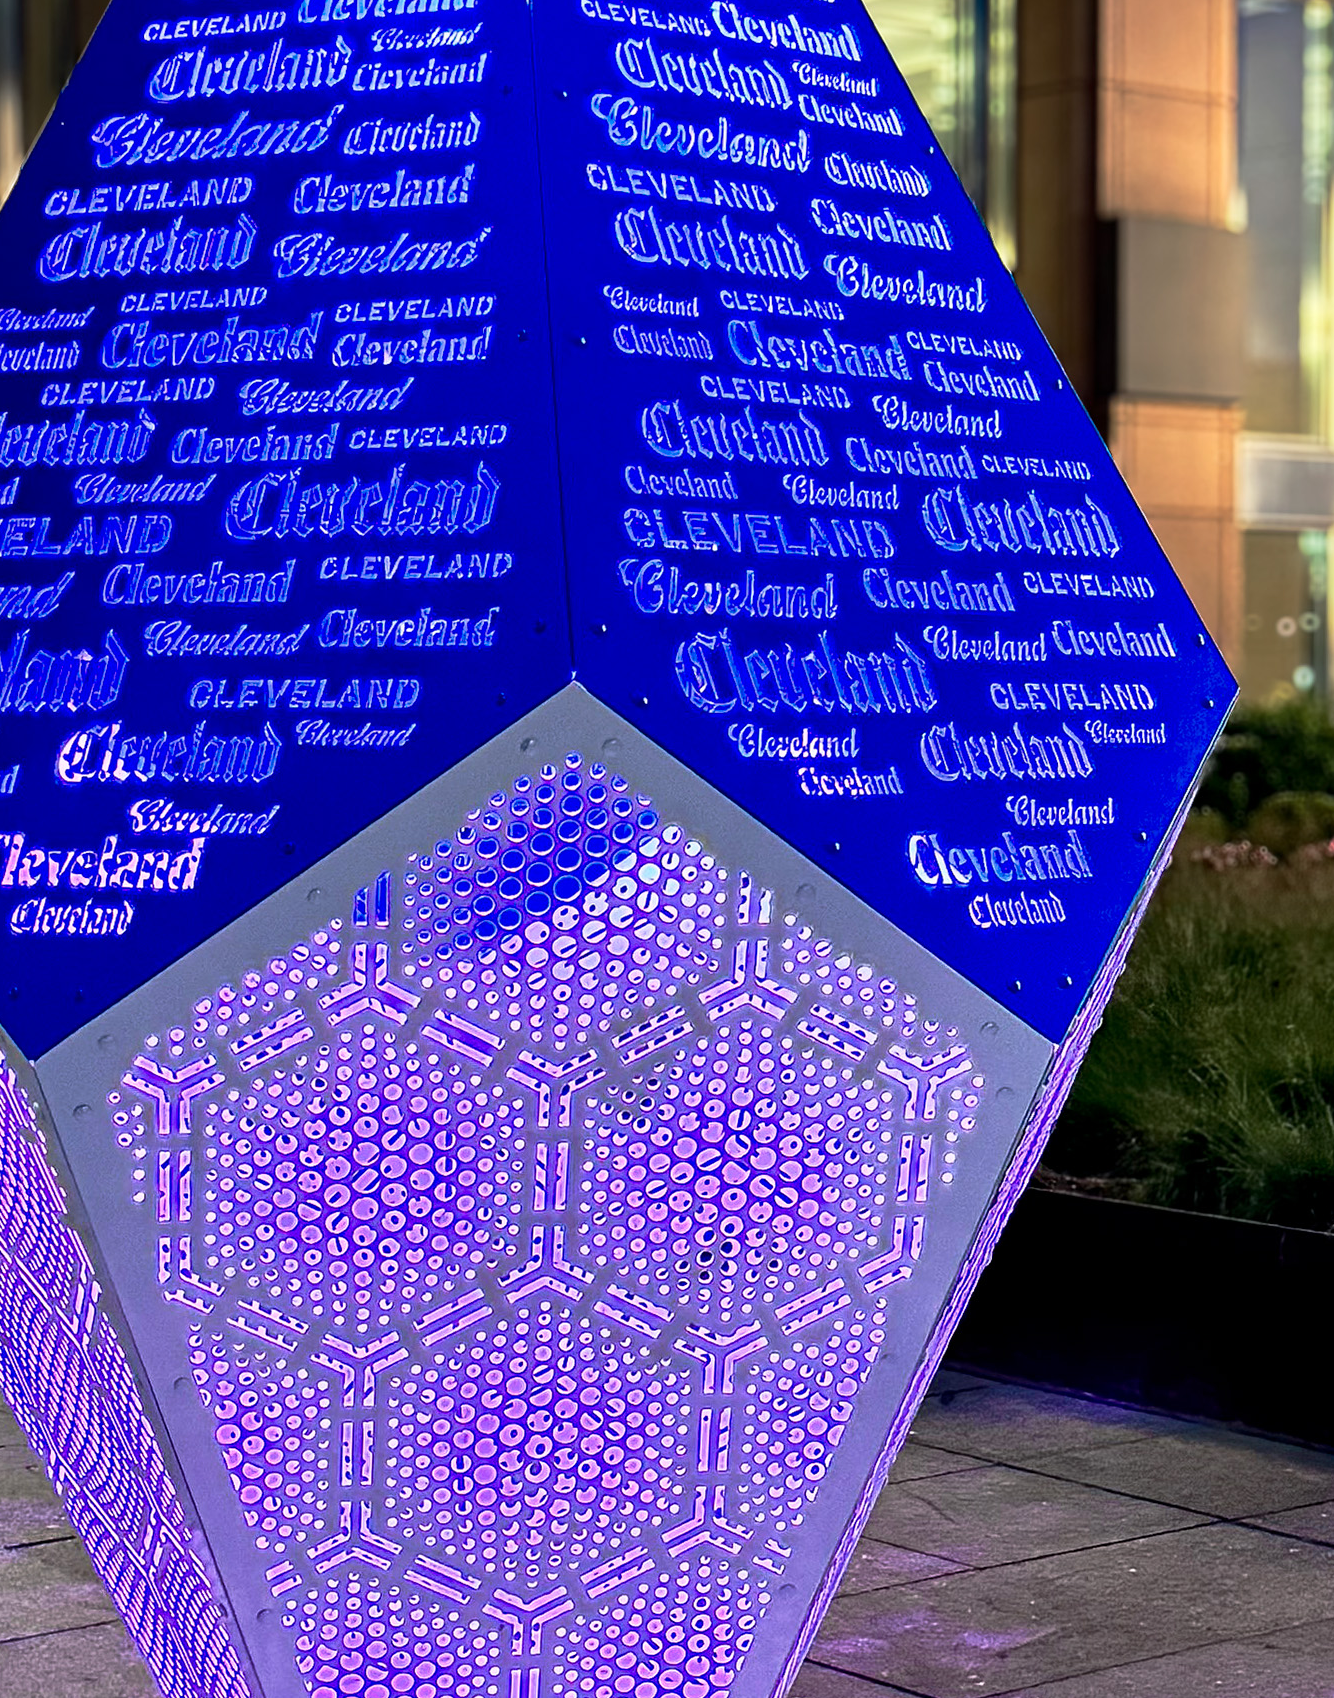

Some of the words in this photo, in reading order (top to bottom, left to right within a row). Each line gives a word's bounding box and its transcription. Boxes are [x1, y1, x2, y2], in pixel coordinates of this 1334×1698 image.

[144, 11, 286, 41] CLEVELAND
[371, 22, 483, 52] Cleveland
[581, 0, 713, 37] CLEVELAND
[710, 0, 862, 62] Cleveland
[149, 33, 352, 103] Cleveland
[352, 53, 487, 91] Cleveland
[615, 37, 796, 110] Cleveland
[792, 59, 879, 97] Cleveland
[343, 112, 481, 155] Cleveland
[591, 93, 815, 173] Cleveland
[798, 94, 905, 138] Cleveland
[92, 104, 344, 168] Cleveland
[294, 163, 475, 214] Cleveland
[586, 164, 778, 212] CLEVELAND
[824, 151, 932, 197] Cleveland
[45, 177, 252, 216] CLEVELAND
[615, 206, 809, 280] Cleveland
[811, 198, 953, 251] Cleveland
[40, 213, 257, 281] Cleveland
[273, 227, 491, 278] Cleveland
[121, 287, 267, 313] CLEVELAND
[603, 285, 699, 317] Cleveland
[720, 290, 844, 321] CLEVELAND
[823, 254, 988, 321] Cleveland
[335, 296, 496, 322] CLEVELAND
[102, 311, 324, 368] Cleveland
[332, 326, 492, 367] Cleveland
[613, 325, 713, 360] Cleveland
[728, 320, 913, 380] Cleveland
[906, 331, 1023, 360] CLEVELAND
[41, 377, 215, 405] CLEVELAND
[239, 377, 414, 416] Cleveland
[700, 375, 851, 408] CLEVELAND
[923, 361, 1040, 401] Cleveland
[641, 399, 829, 466] Cleveland
[872, 395, 1002, 438] Cleveland
[172, 423, 340, 463] Cleveland
[349, 425, 507, 449] CLEVELAND
[846, 437, 978, 479] Cleveland
[982, 455, 1091, 480] CLEVELAND
[75, 473, 217, 504] Cleveland
[225, 461, 499, 540] Cleveland
[625, 466, 738, 499] Cleveland
[783, 474, 899, 509] Cleveland
[624, 508, 894, 558] CLEVELAND
[922, 484, 1120, 558] Cleveland
[103, 559, 296, 604] Cleveland
[320, 553, 512, 580] CLEVELAND
[1023, 572, 1154, 598] CLEVELAND
[619, 559, 838, 619] Cleveland
[863, 568, 1015, 612] Cleveland
[144, 620, 310, 656] Cleveland
[318, 607, 500, 647] Cleveland
[923, 625, 1047, 661] Cleveland
[1051, 620, 1177, 657] Cleveland
[675, 626, 942, 713] Cleveland
[190, 679, 419, 708] CLEVELAND
[990, 683, 1154, 710] CLEVELAND
[296, 720, 416, 746] Cleveland
[728, 724, 859, 761] Cleveland
[920, 720, 1102, 781] Cleveland
[1084, 720, 1166, 744] Cleveland
[54, 720, 282, 785] Cleveland
[798, 766, 903, 799] Cleveland
[127, 799, 280, 835] Cleveland
[1006, 795, 1115, 826] Cleveland
[905, 829, 1093, 890] Cleveland
[10, 897, 135, 935] Cleveland
[969, 891, 1066, 928] Cleveland
